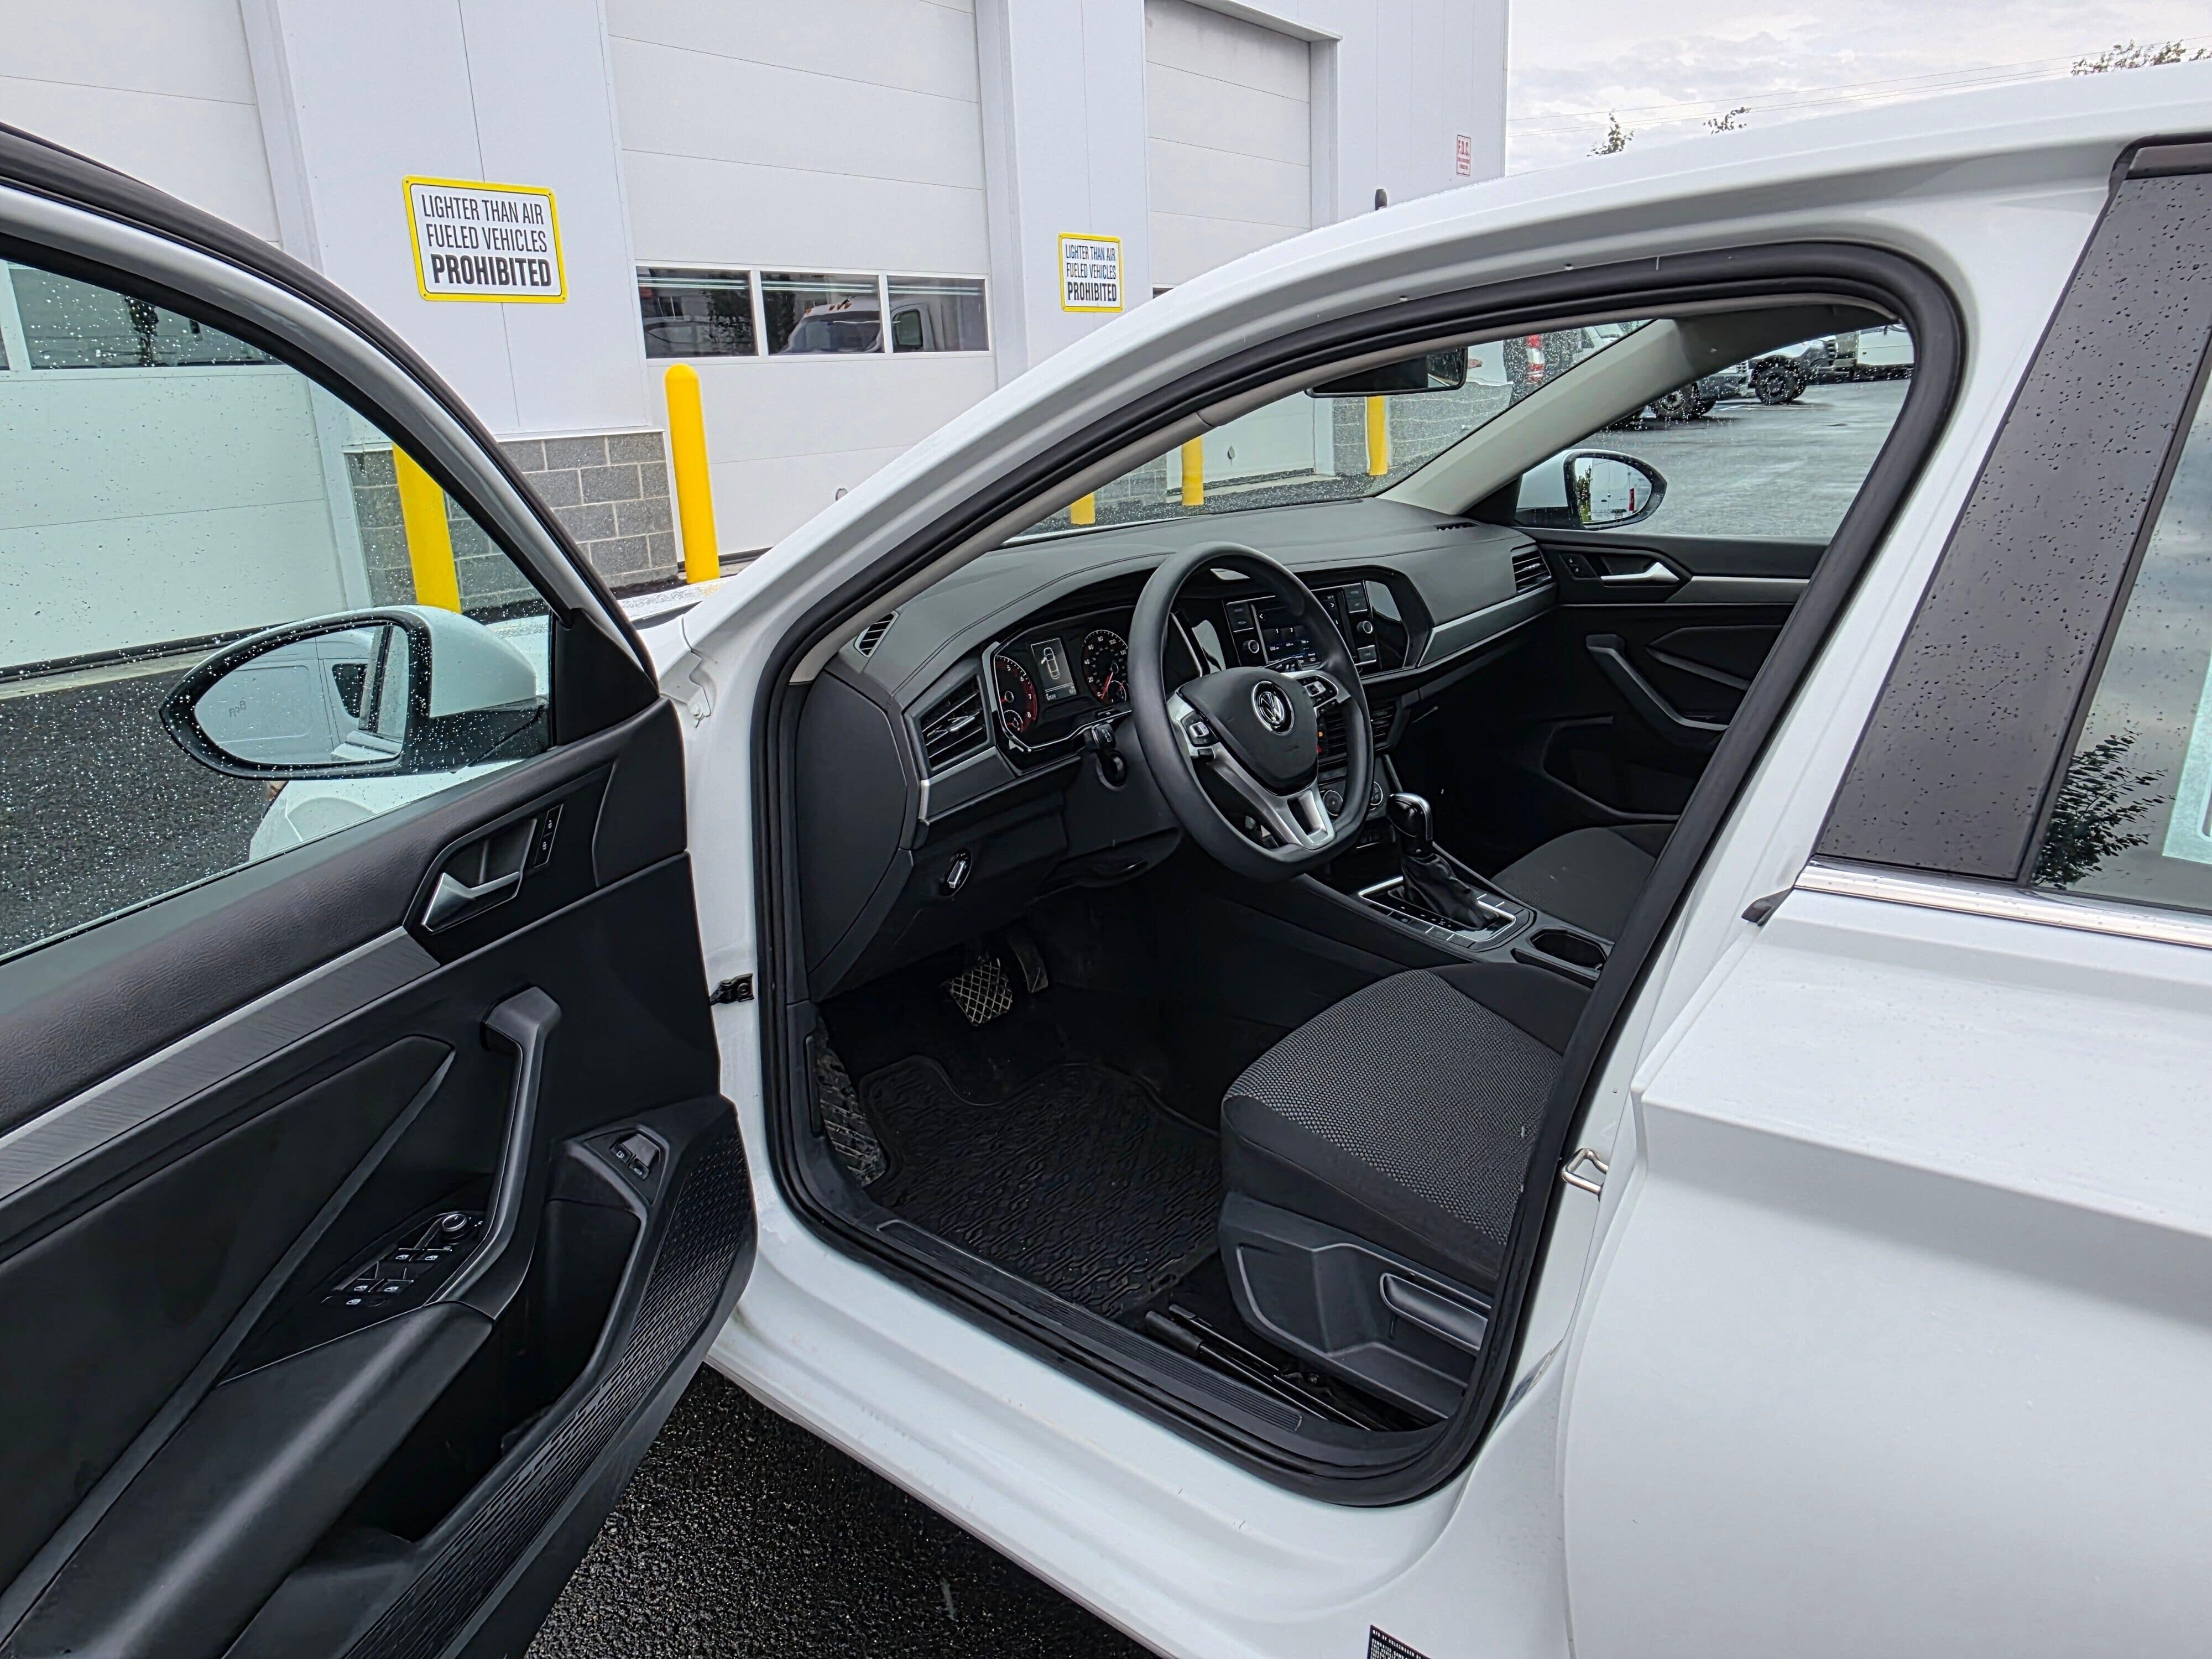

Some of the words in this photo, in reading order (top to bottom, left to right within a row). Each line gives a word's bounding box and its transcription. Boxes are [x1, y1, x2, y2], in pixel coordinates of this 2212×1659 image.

[421, 194, 481, 221] LIGHTER
[482, 199, 519, 223] THAN
[523, 202, 544, 225] AIR
[426, 223, 479, 249] FUELED
[482, 227, 547, 253] VEHICLES
[1065, 244, 1089, 260] LIGHTER
[1090, 246, 1105, 261] THAN
[1107, 248, 1116, 262] AIR
[430, 253, 552, 287] PROHIBITED
[1066, 262, 1088, 278] FUELED
[1089, 264, 1117, 280] VEHICLES
[1067, 281, 1117, 301] PROHIBITED
